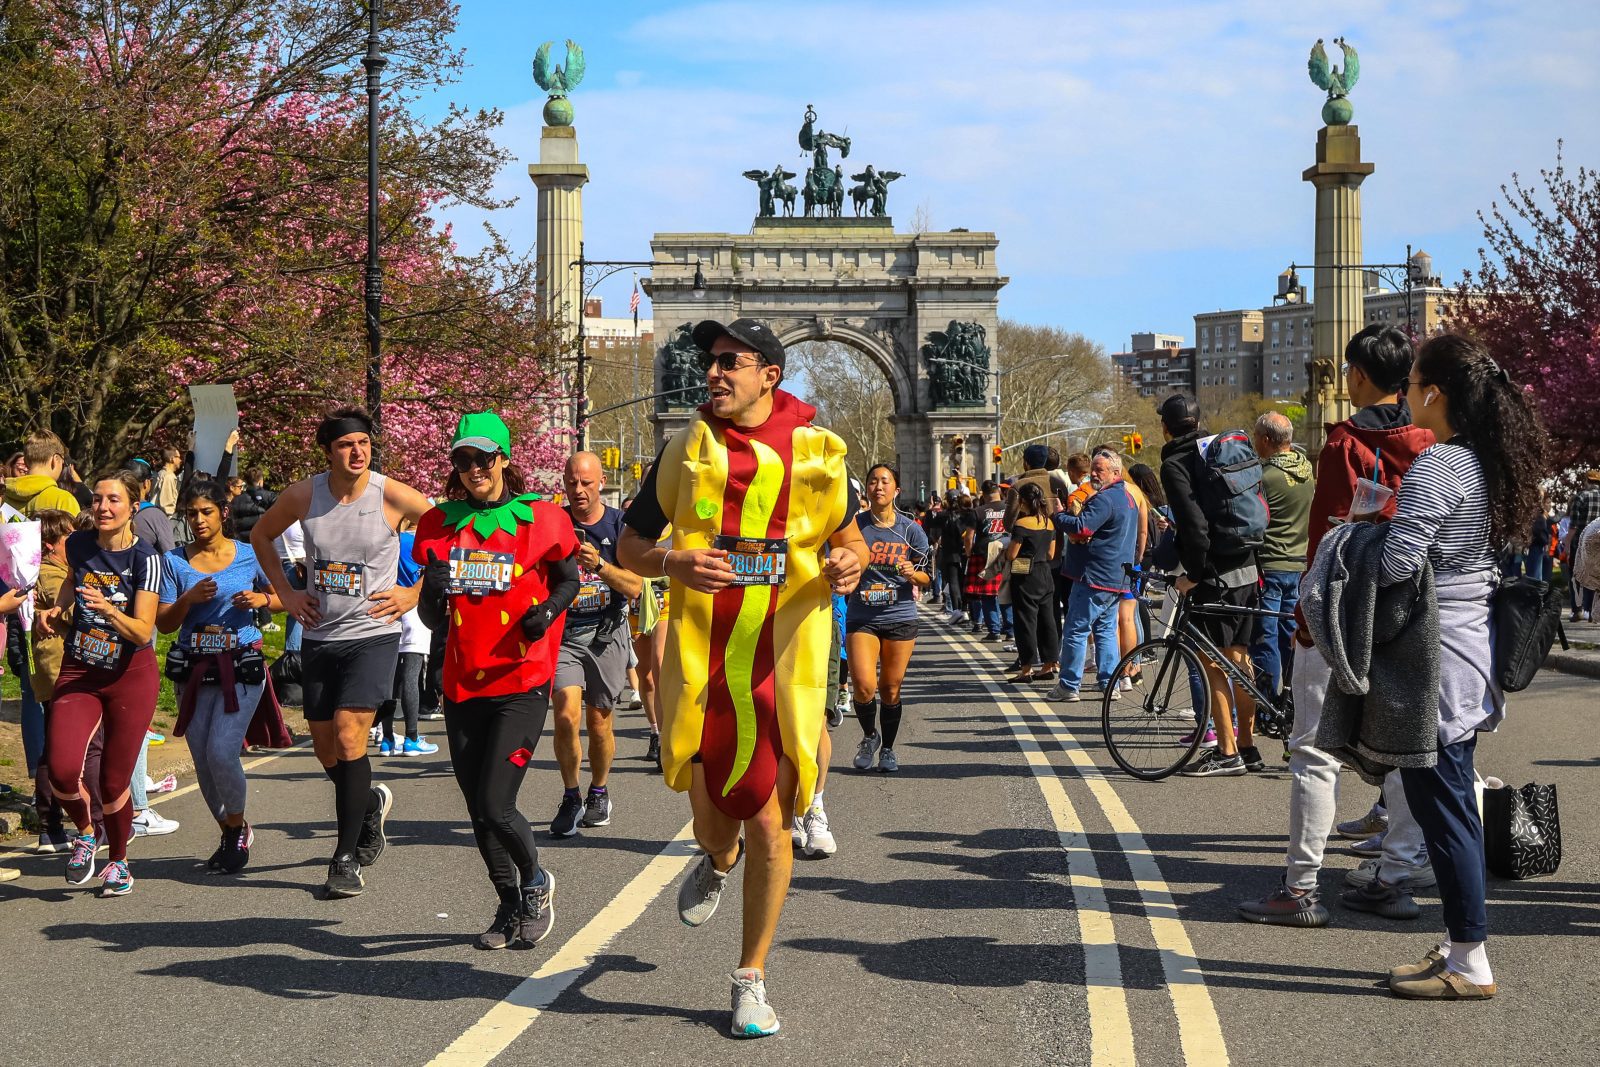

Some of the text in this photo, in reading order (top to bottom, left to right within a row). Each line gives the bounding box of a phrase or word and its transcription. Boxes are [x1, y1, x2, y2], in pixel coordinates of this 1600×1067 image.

[872, 541, 909, 554] CITY
[461, 563, 500, 579] 28003
[727, 553, 773, 573] 28004
[322, 572, 351, 588] 14269
[83, 635, 110, 656] 27313
[200, 634, 227, 647] 22152
